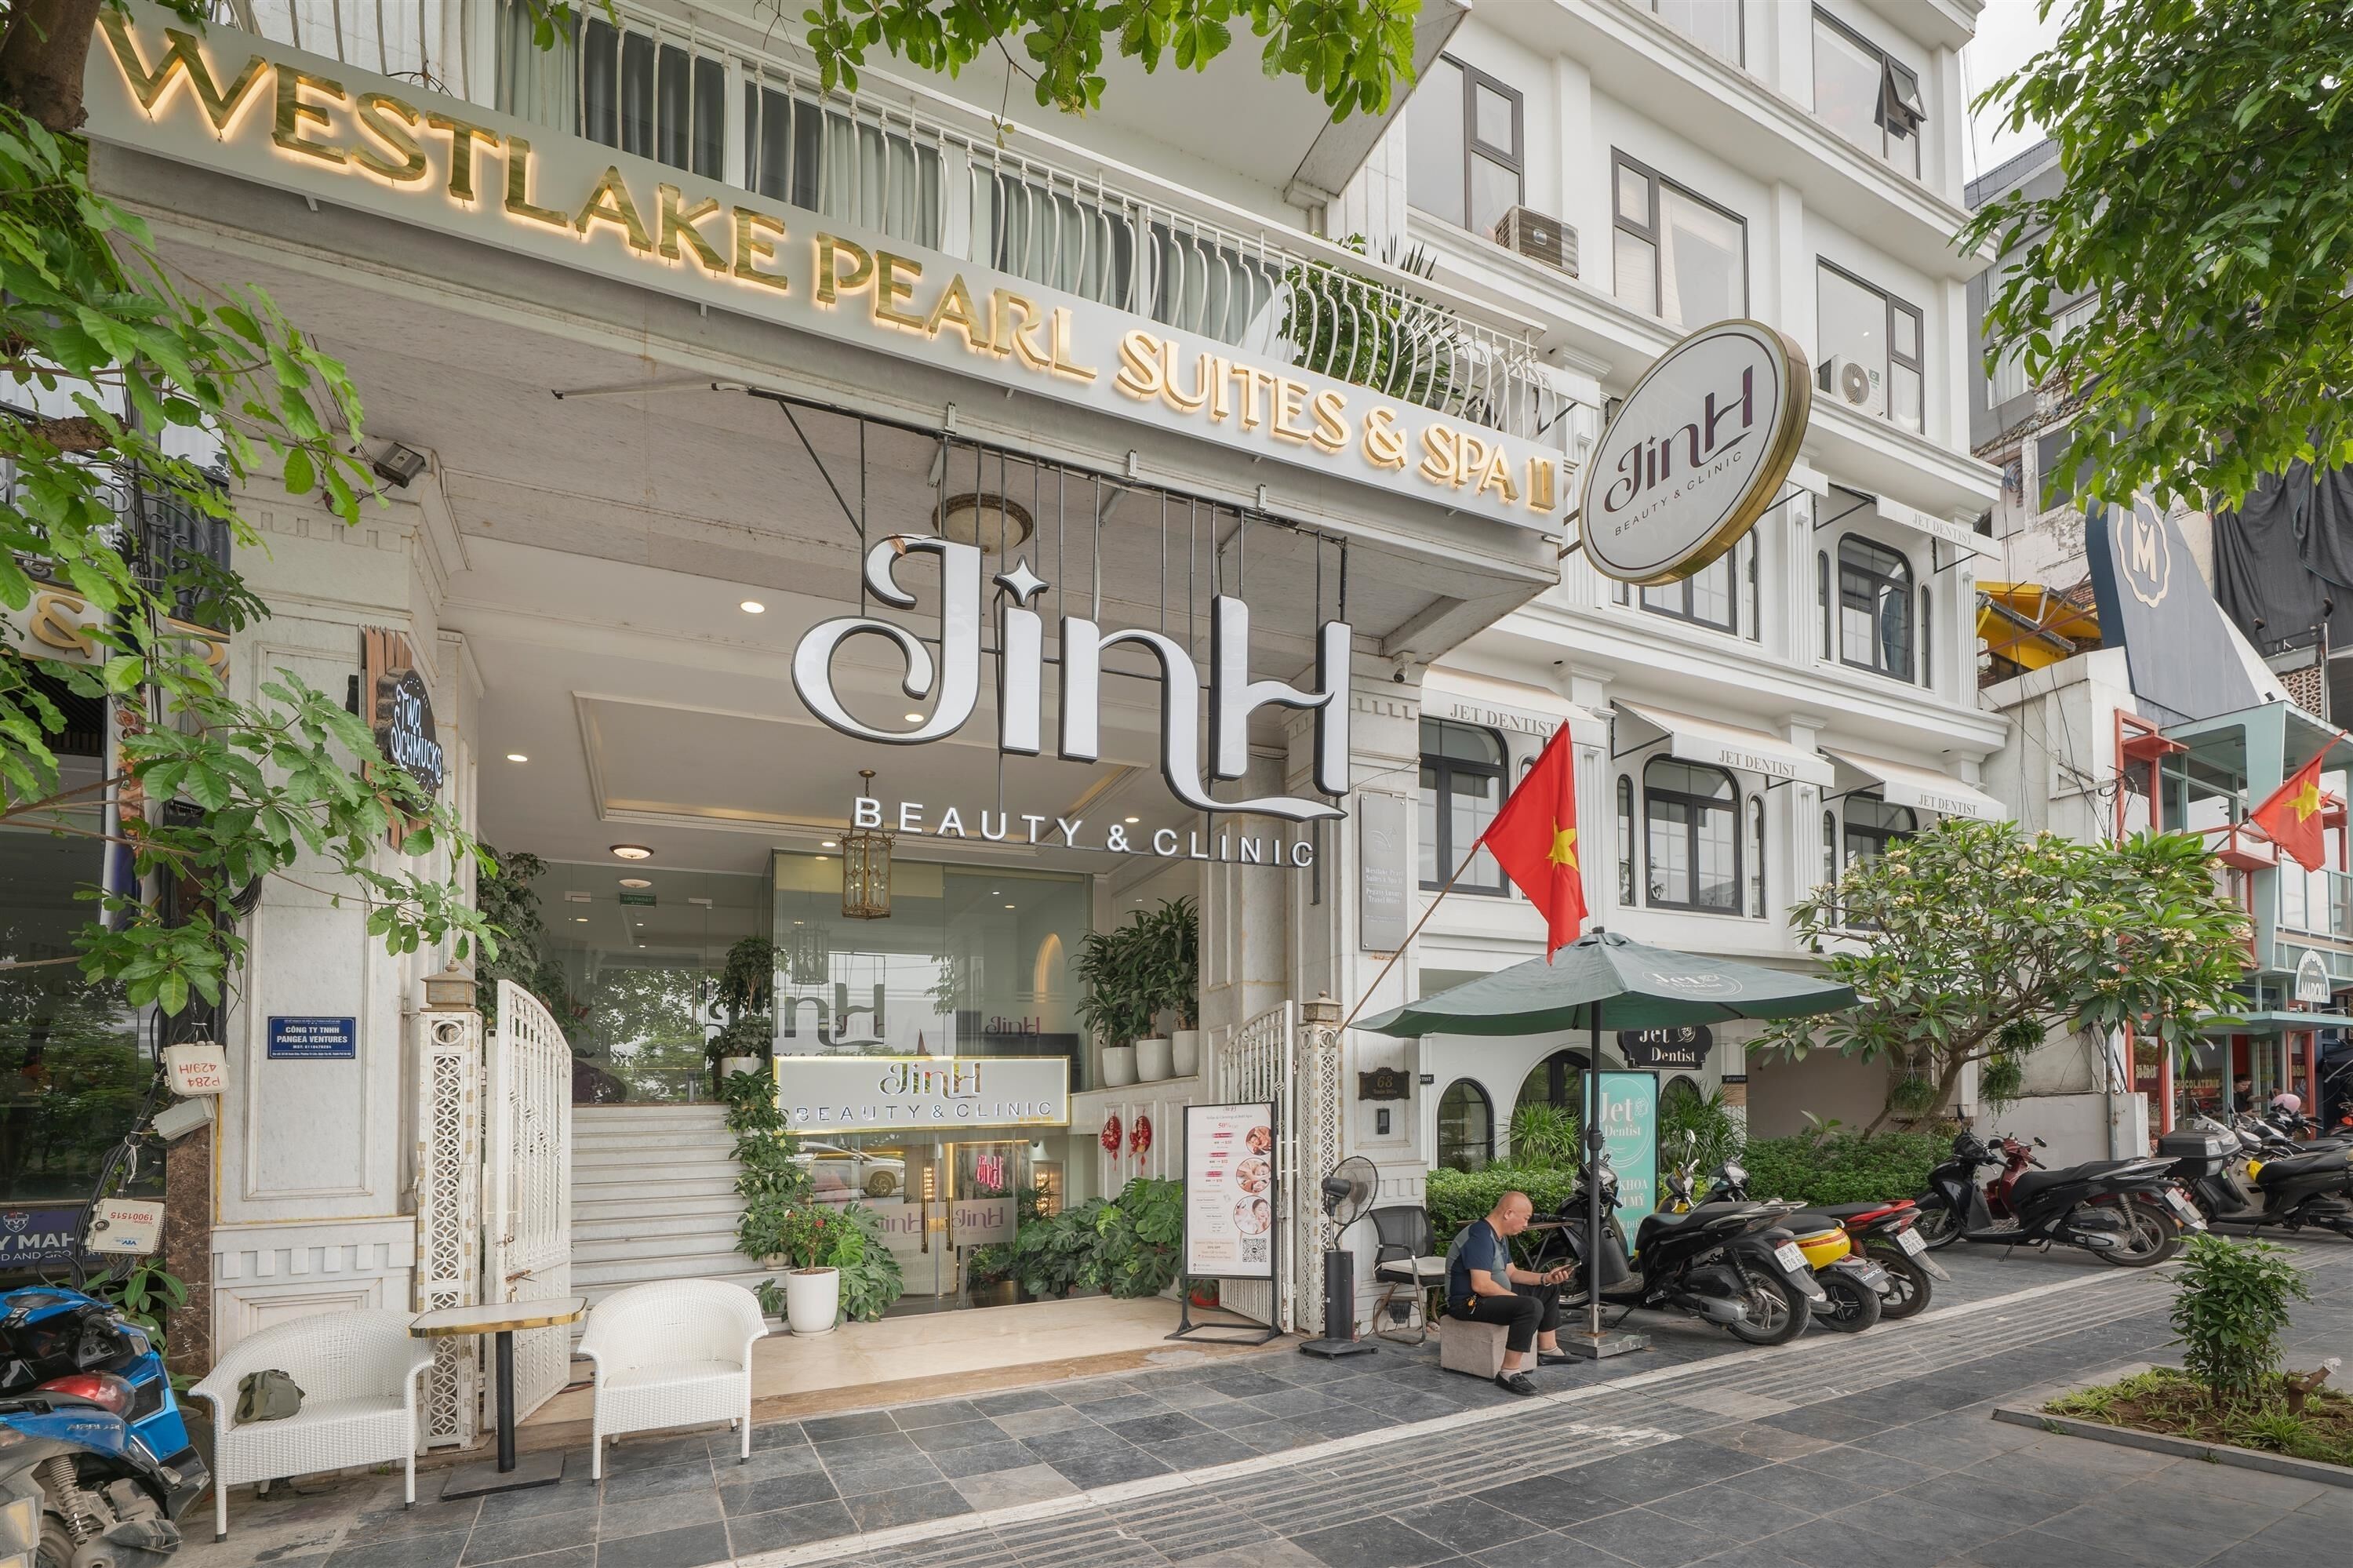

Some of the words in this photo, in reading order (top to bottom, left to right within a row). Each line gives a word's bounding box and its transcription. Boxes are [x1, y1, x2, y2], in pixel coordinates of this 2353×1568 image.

[96, 7, 787, 291] WESTLAKE
[816, 232, 1096, 380] PEARL
[1117, 329, 1352, 449] SUITES
[1362, 406, 1408, 470] &
[1421, 424, 1519, 502] SPA
[1615, 497, 1669, 537] BEAUTY
[1674, 489, 1682, 499] &
[1687, 451, 1743, 490] CLINIC
[1912, 514, 1931, 531] JET
[1933, 522, 1971, 545] DENTIST
[395, 684, 421, 729] TWO
[1450, 703, 1482, 722] JET
[1487, 710, 1557, 736] DENTIST
[391, 705, 443, 785] SCHMUCKS
[1718, 750, 1743, 766] JET
[1744, 754, 1798, 777] DENTIST
[1918, 794, 1938, 808] JET
[1939, 797, 1978, 817] DENTIST
[853, 796, 1085, 849] BEAUTY
[1107, 824, 1131, 853] &
[1153, 828, 1315, 868] CLINIC
[1651, 1047, 1697, 1062] Dentist
[187, 1076, 220, 1088] P284
[1377, 1075, 1394, 1088] 68
[795, 1105, 921, 1122] BEAUTY
[933, 1104, 944, 1118] &
[955, 1101, 1053, 1117] CLINIC
[1605, 1125, 1642, 1137] Dentist
[1618, 1179, 1649, 1191] KHOA
[110, 1212, 154, 1221] 19001515
[13, 1251, 42, 1261] AND
